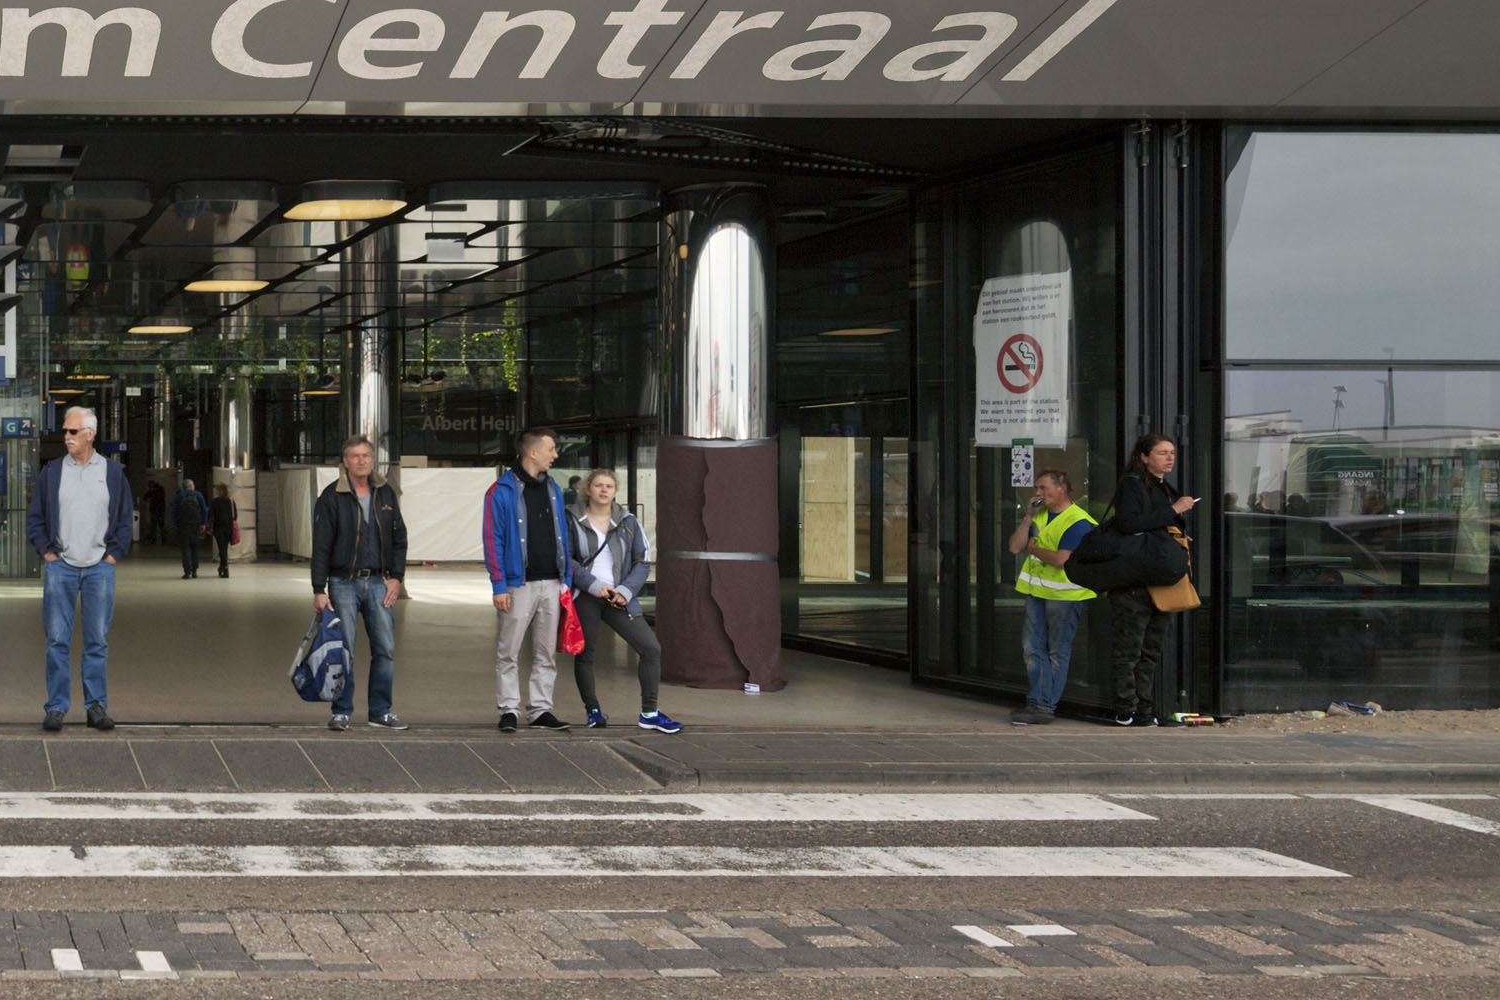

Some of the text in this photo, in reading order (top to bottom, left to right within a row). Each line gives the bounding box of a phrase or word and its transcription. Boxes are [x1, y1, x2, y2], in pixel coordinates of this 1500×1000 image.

[6, 422, 16, 433] G
[422, 415, 516, 435] Albert Heij
